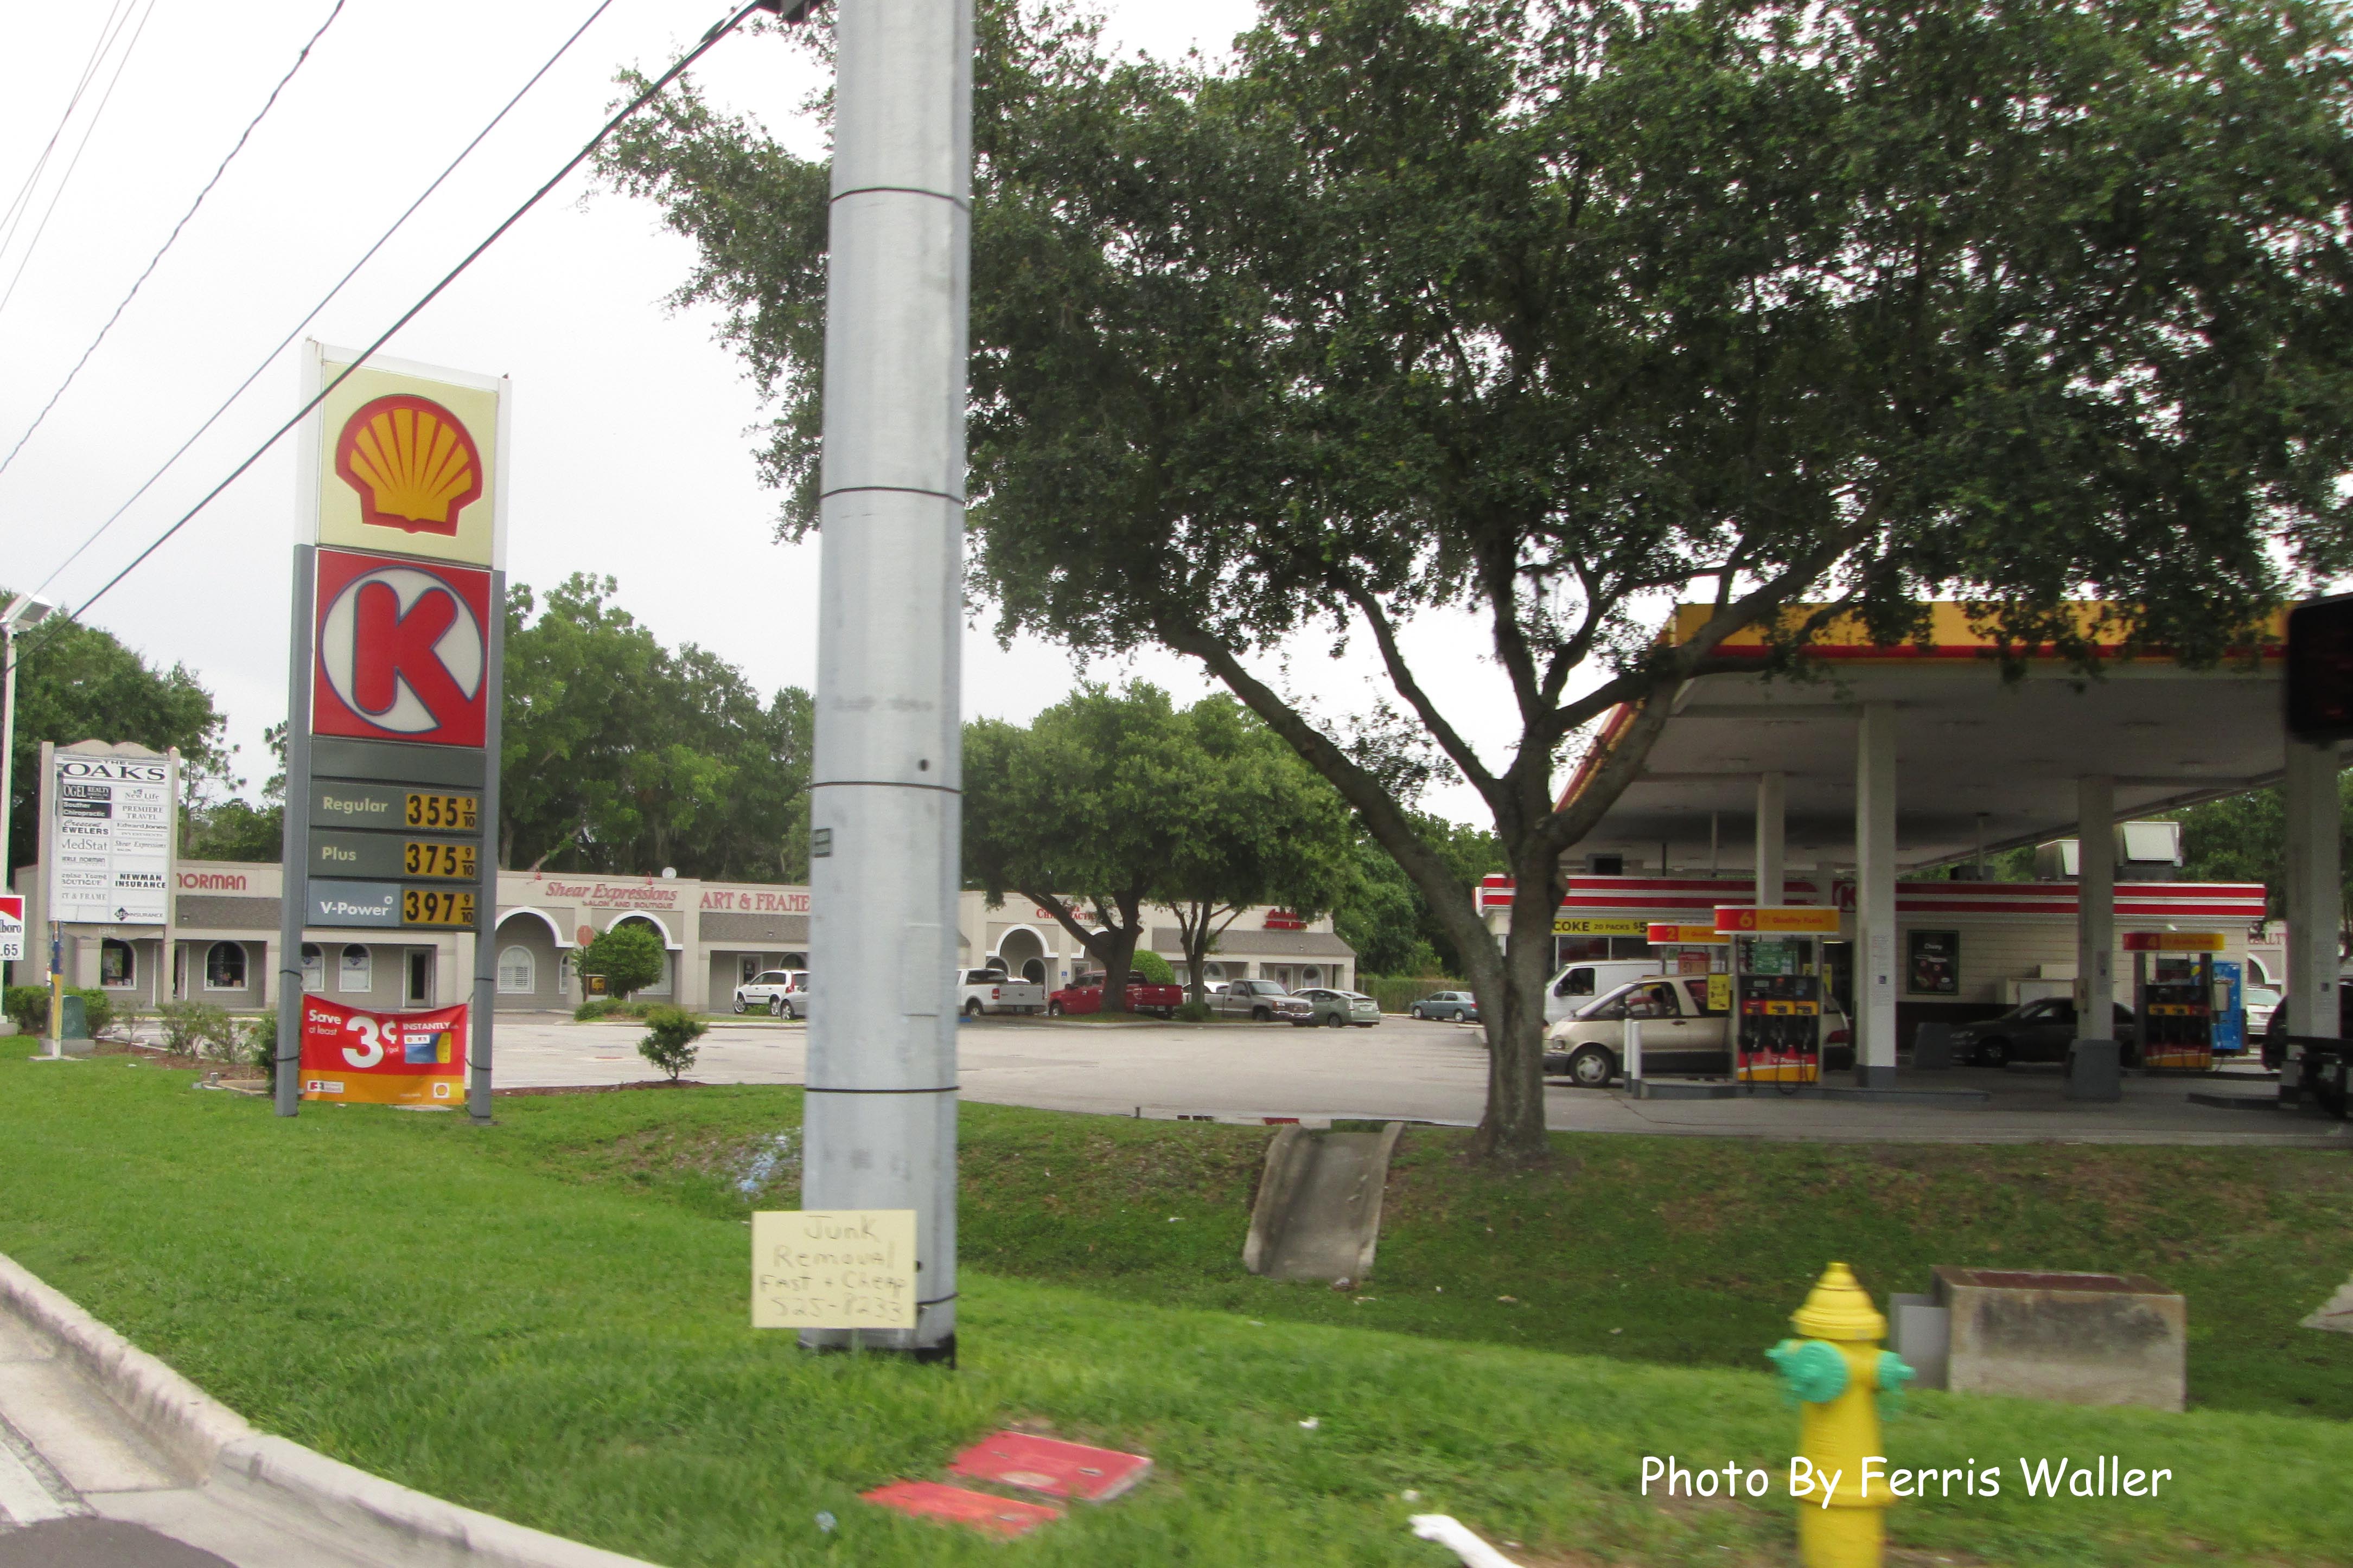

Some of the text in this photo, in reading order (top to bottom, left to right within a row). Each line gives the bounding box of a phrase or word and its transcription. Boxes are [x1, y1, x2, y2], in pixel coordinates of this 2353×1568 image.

[350, 578, 473, 729] K
[63, 763, 165, 780] OAKS
[63, 785, 86, 798] OGEL
[323, 796, 389, 814] Regular
[409, 795, 458, 827] 355
[62, 827, 109, 835] EWELERS
[322, 847, 357, 861] Plus
[406, 844, 457, 875] 375
[120, 873, 162, 881] NEWMAN
[546, 882, 678, 901] Shear Expressions
[320, 901, 390, 917] V-Power
[406, 892, 455, 921] 397
[699, 892, 810, 912] ART & FRAME
[1554, 921, 1590, 932] COKE
[1739, 912, 1753, 927] 6
[1666, 927, 1676, 940] 2
[0, 944, 18, 956] .65
[309, 1009, 451, 1068] Save 3 ¢ INSTANTLY
[317, 1025, 338, 1035] least
[803, 1214, 881, 1242] Junk
[773, 1241, 897, 1269] Removal
[759, 1273, 814, 1291] Fast
